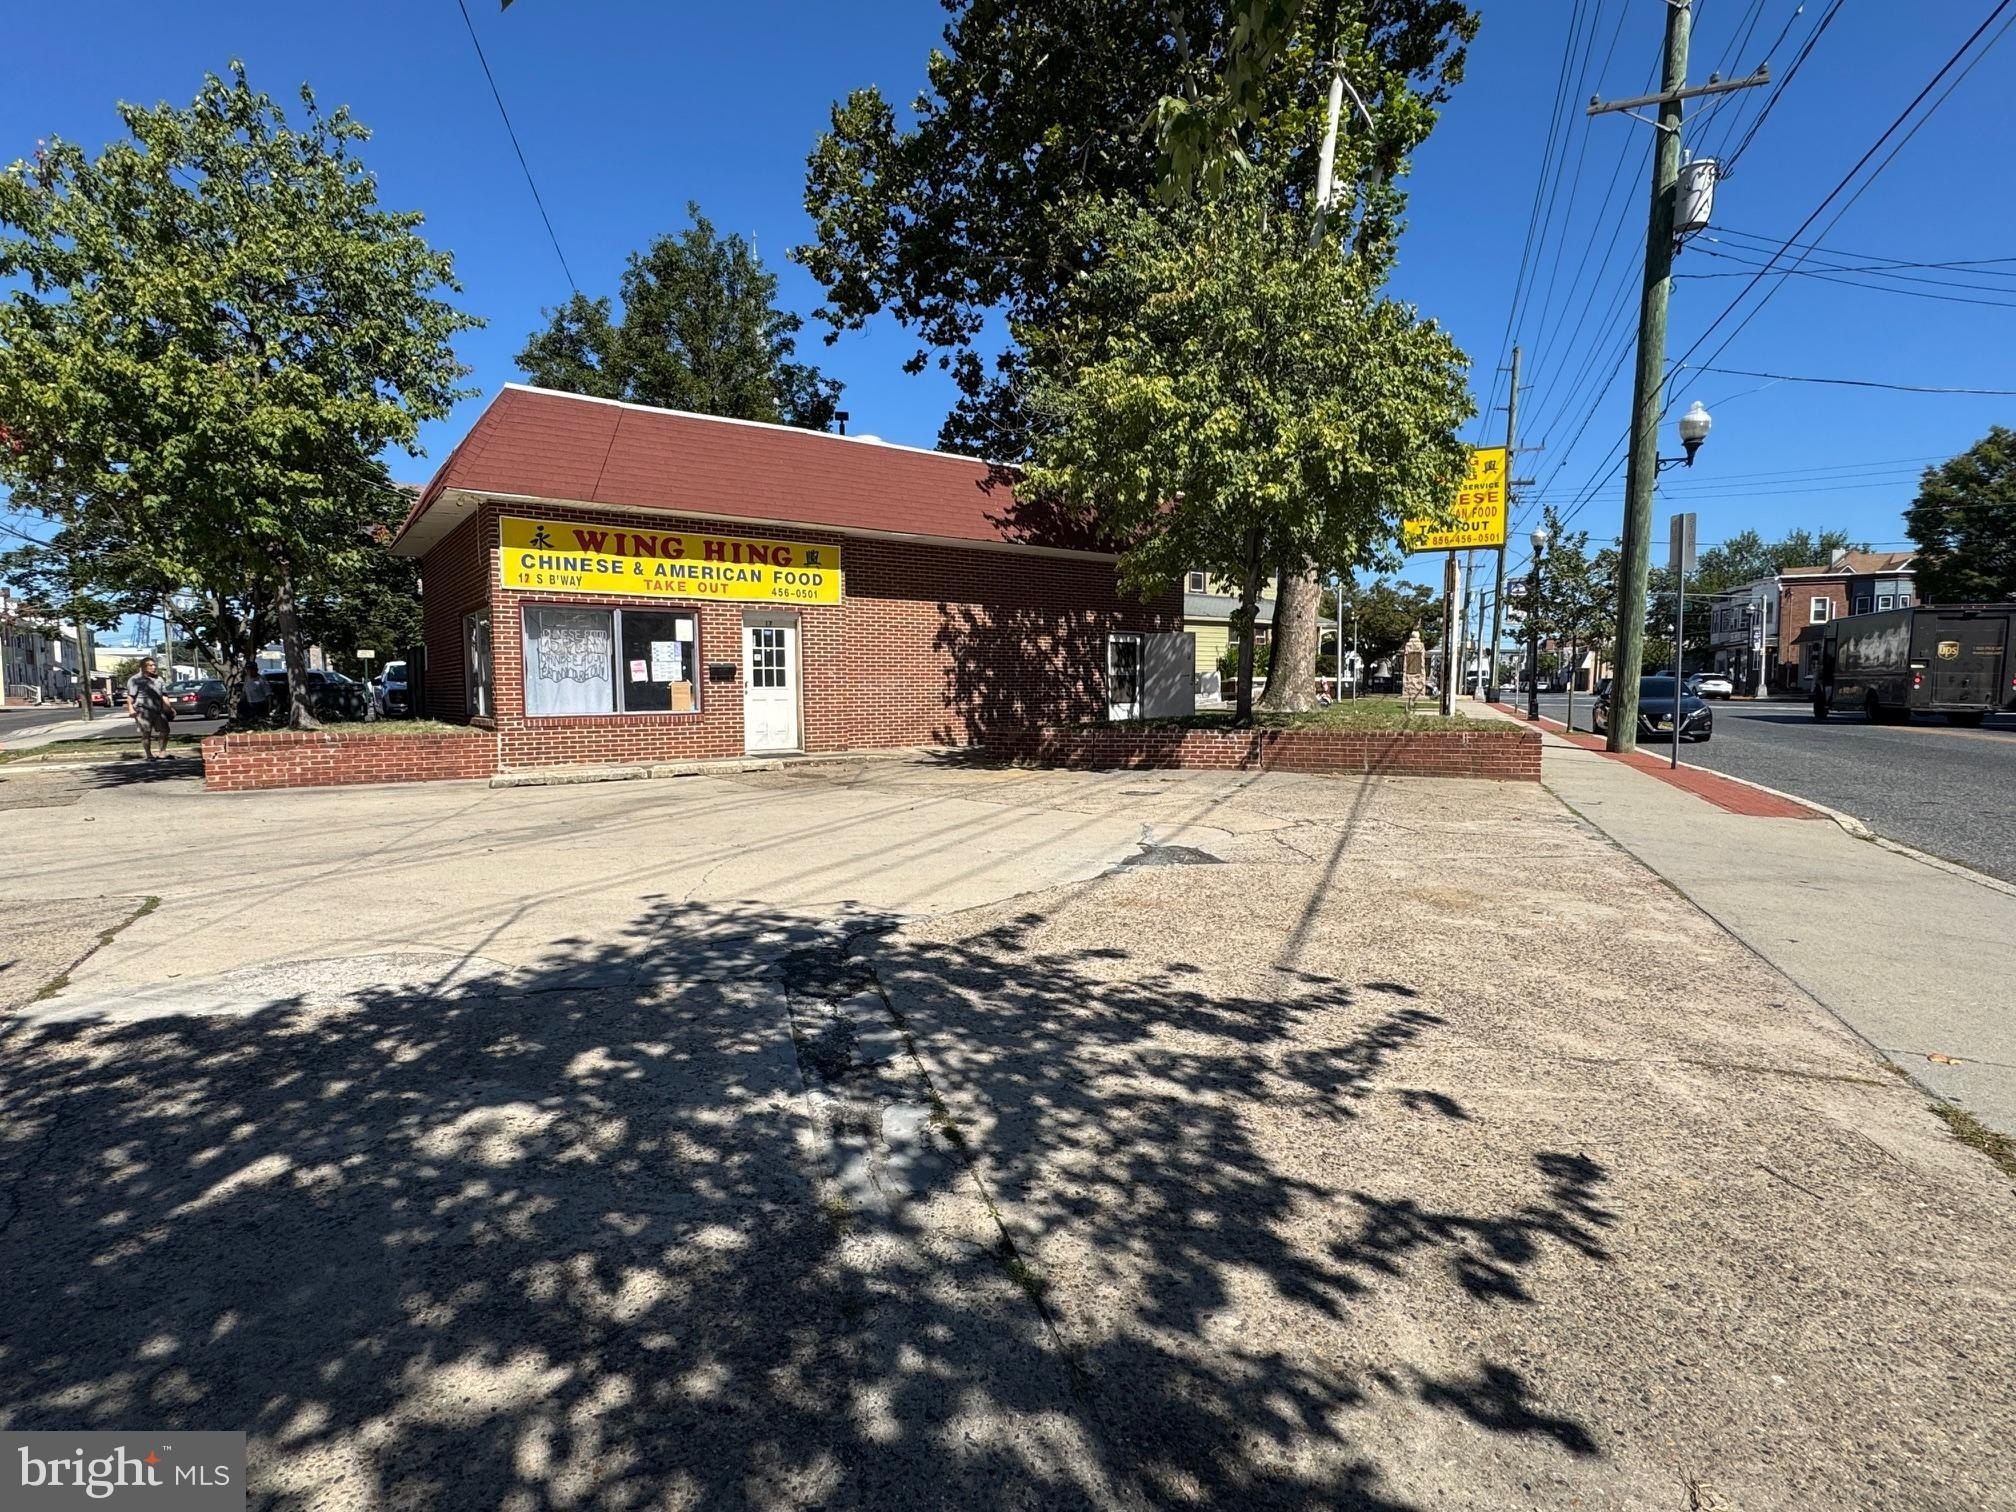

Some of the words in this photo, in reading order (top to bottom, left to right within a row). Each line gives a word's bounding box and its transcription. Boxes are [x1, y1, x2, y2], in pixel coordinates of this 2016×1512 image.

[1463, 481, 1500, 490] SERVICE
[1472, 506, 1498, 518] FOOD
[1462, 521, 1490, 532] OUT
[1432, 533, 1500, 546] 856-456-0501
[572, 529, 686, 560] WING
[703, 540, 793, 567] HING
[521, 553, 624, 574] CHINESE
[633, 561, 644, 576] &
[654, 562, 762, 583] AMERICAN
[773, 571, 823, 586] FOOD
[536, 573, 543, 584] S
[549, 574, 583, 587] B'WAY
[643, 578, 687, 592] TAKE
[698, 581, 729, 594] OUT
[771, 587, 819, 599] 456-0501
[1939, 646, 1958, 658] ups
